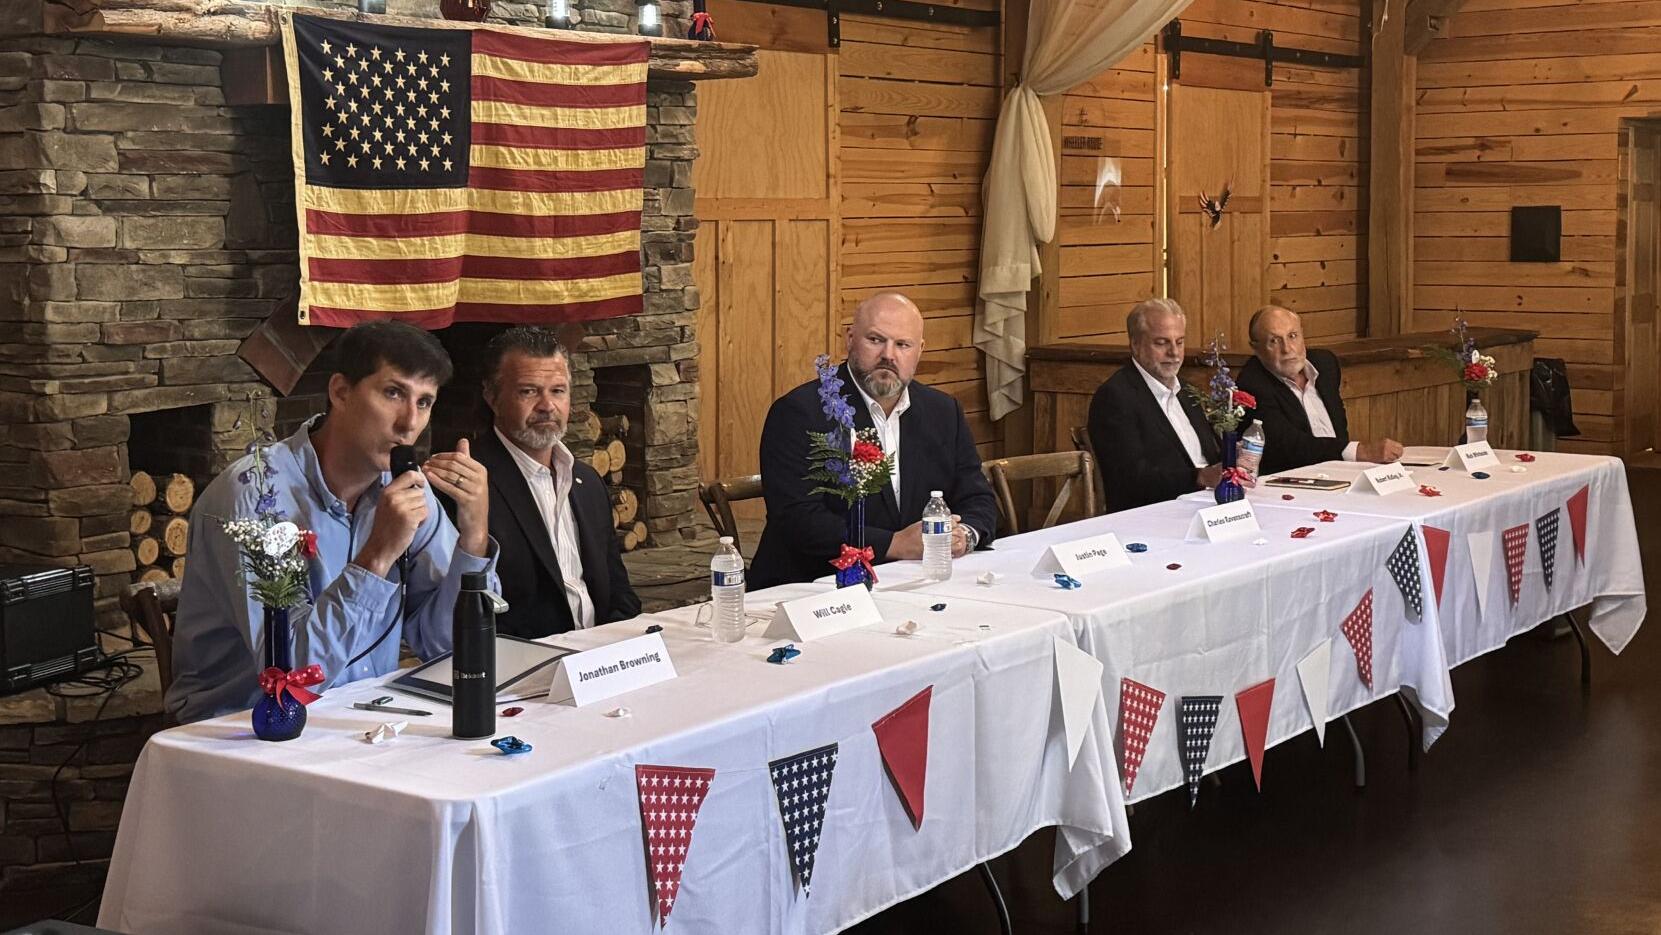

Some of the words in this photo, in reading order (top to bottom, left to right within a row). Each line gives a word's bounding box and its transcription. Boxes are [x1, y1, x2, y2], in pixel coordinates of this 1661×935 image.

[1207, 518, 1226, 527] Charles
[1075, 551, 1093, 561] Justin
[1092, 549, 1108, 557] Page
[813, 607, 831, 619] Will
[829, 603, 853, 615] Cagle
[578, 663, 619, 682] Jonathan
[619, 651, 661, 671] Browning
